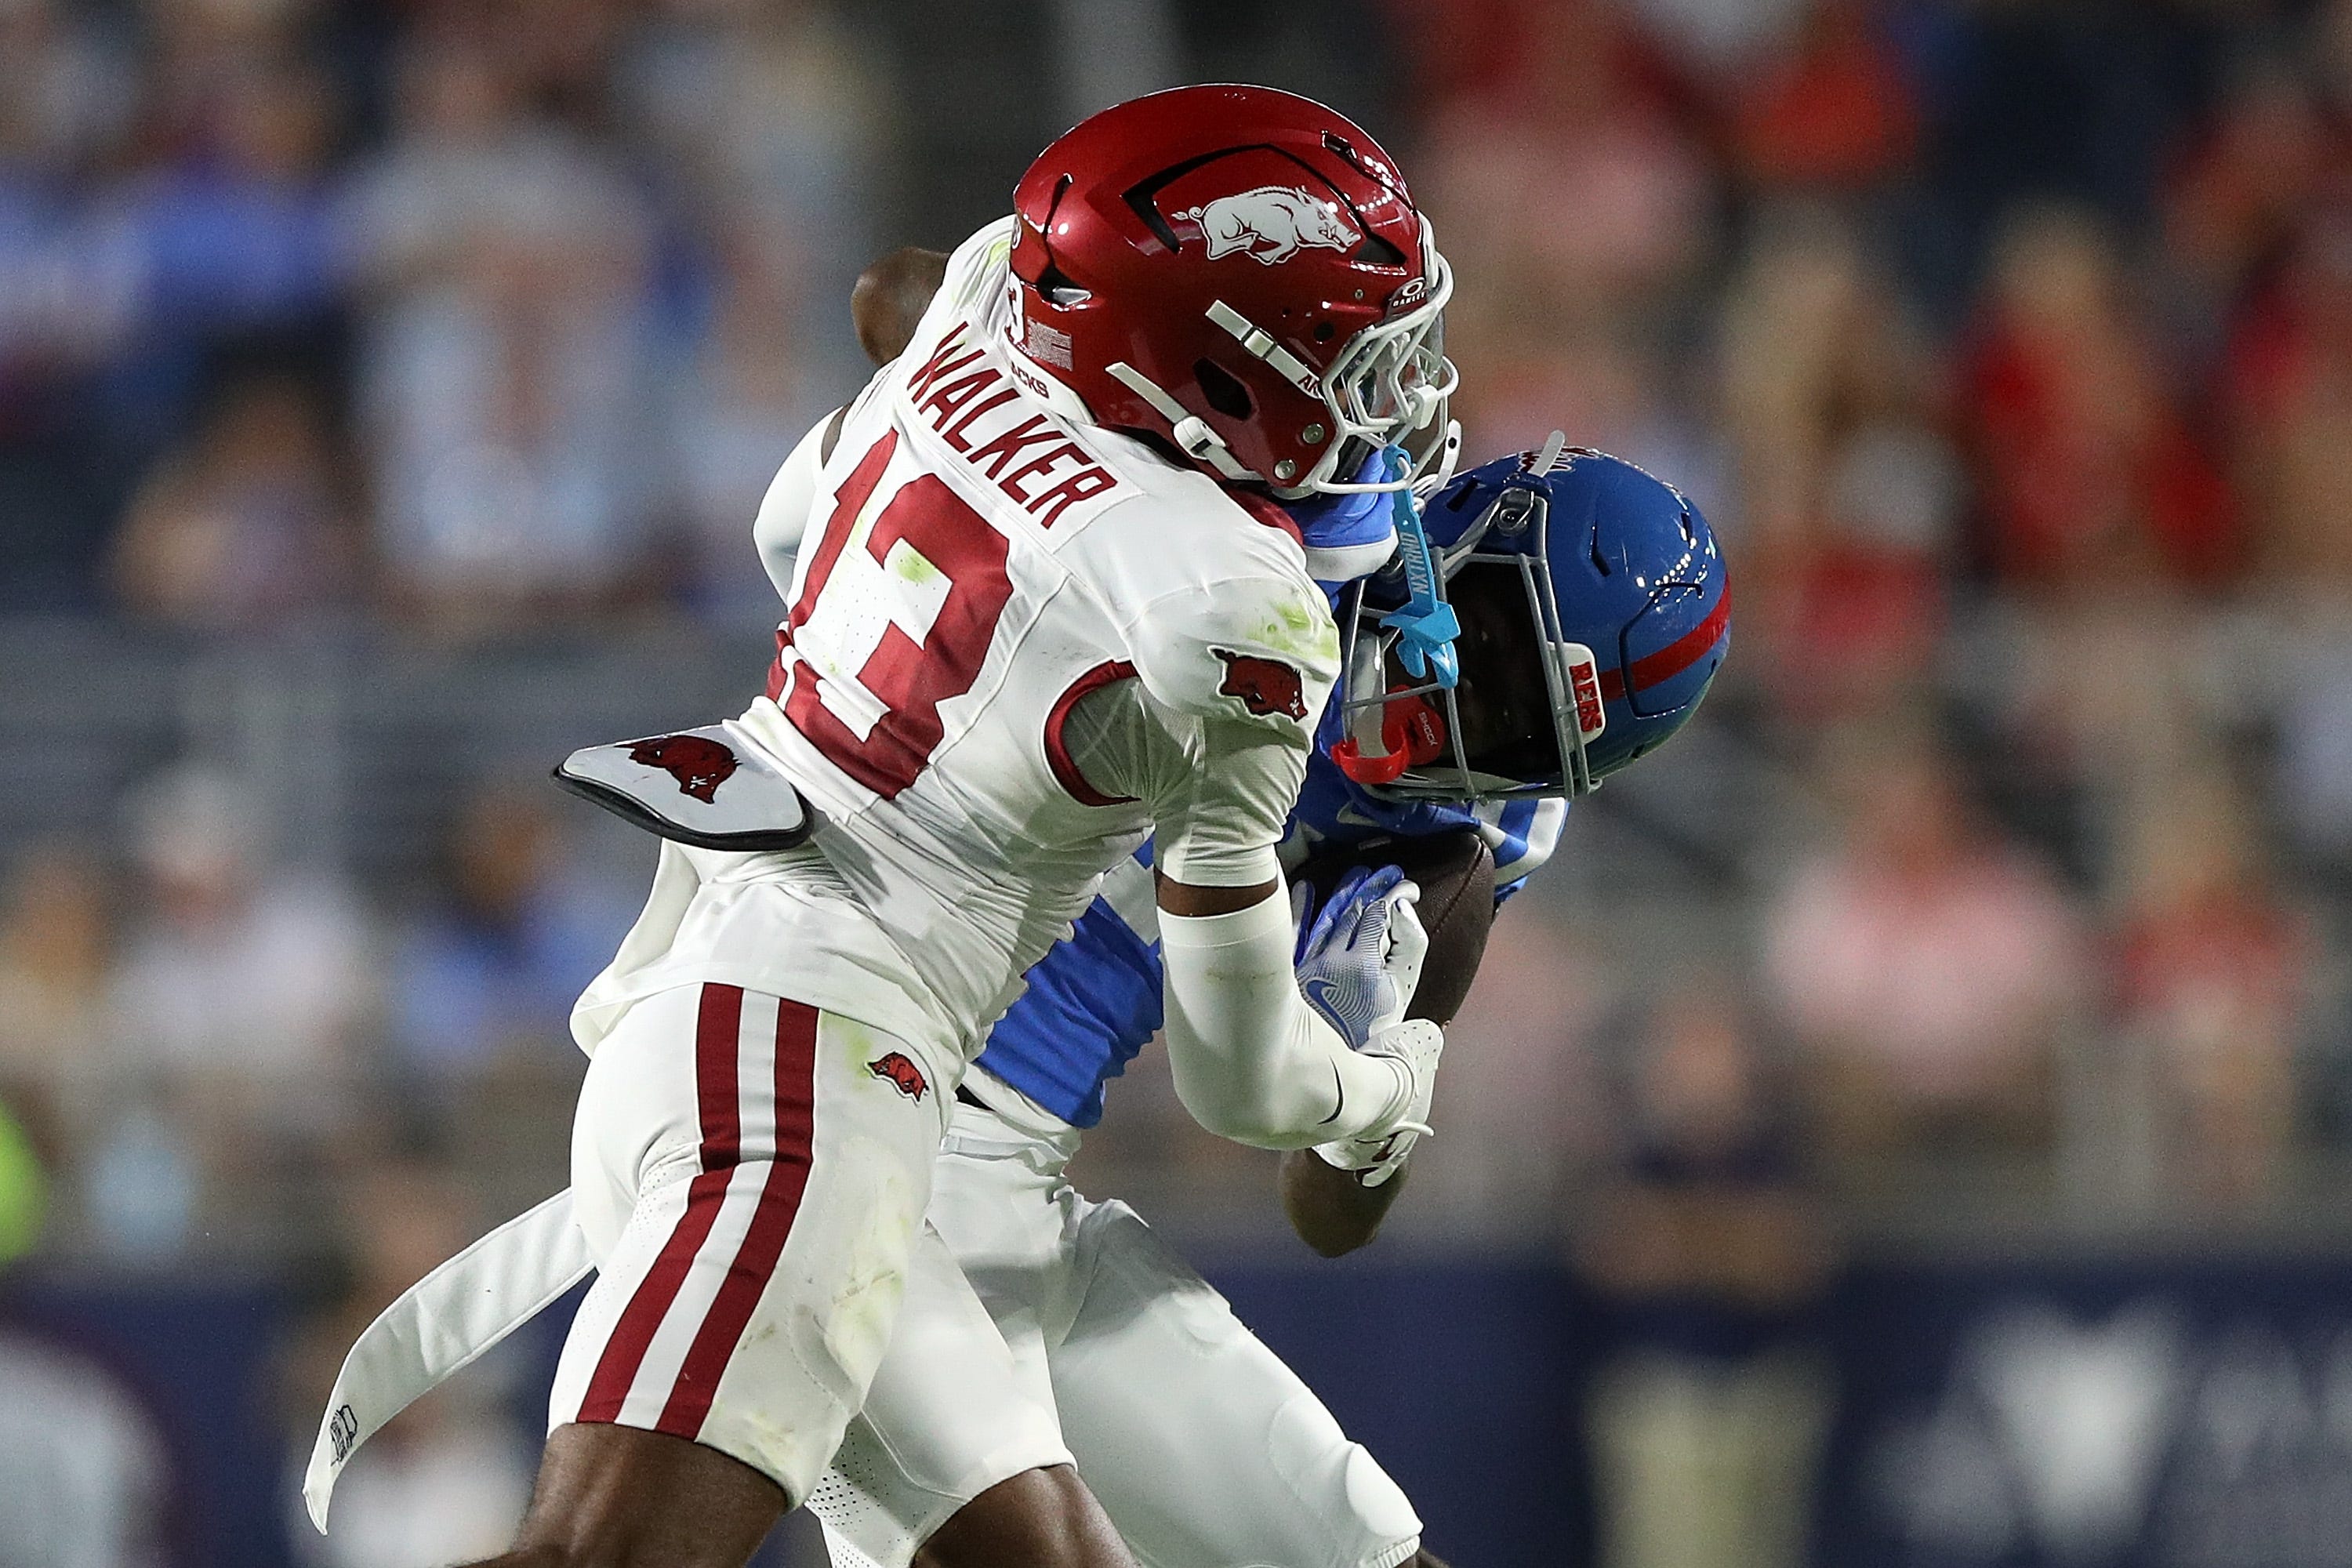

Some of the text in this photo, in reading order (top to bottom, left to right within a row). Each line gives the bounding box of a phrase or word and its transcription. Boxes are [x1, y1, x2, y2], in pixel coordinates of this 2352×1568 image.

[907, 321, 1118, 530] WALKER
[766, 426, 1014, 800] 13
[1399, 532, 1430, 595] NXTRND
[1418, 712, 1438, 746] SHOCK
